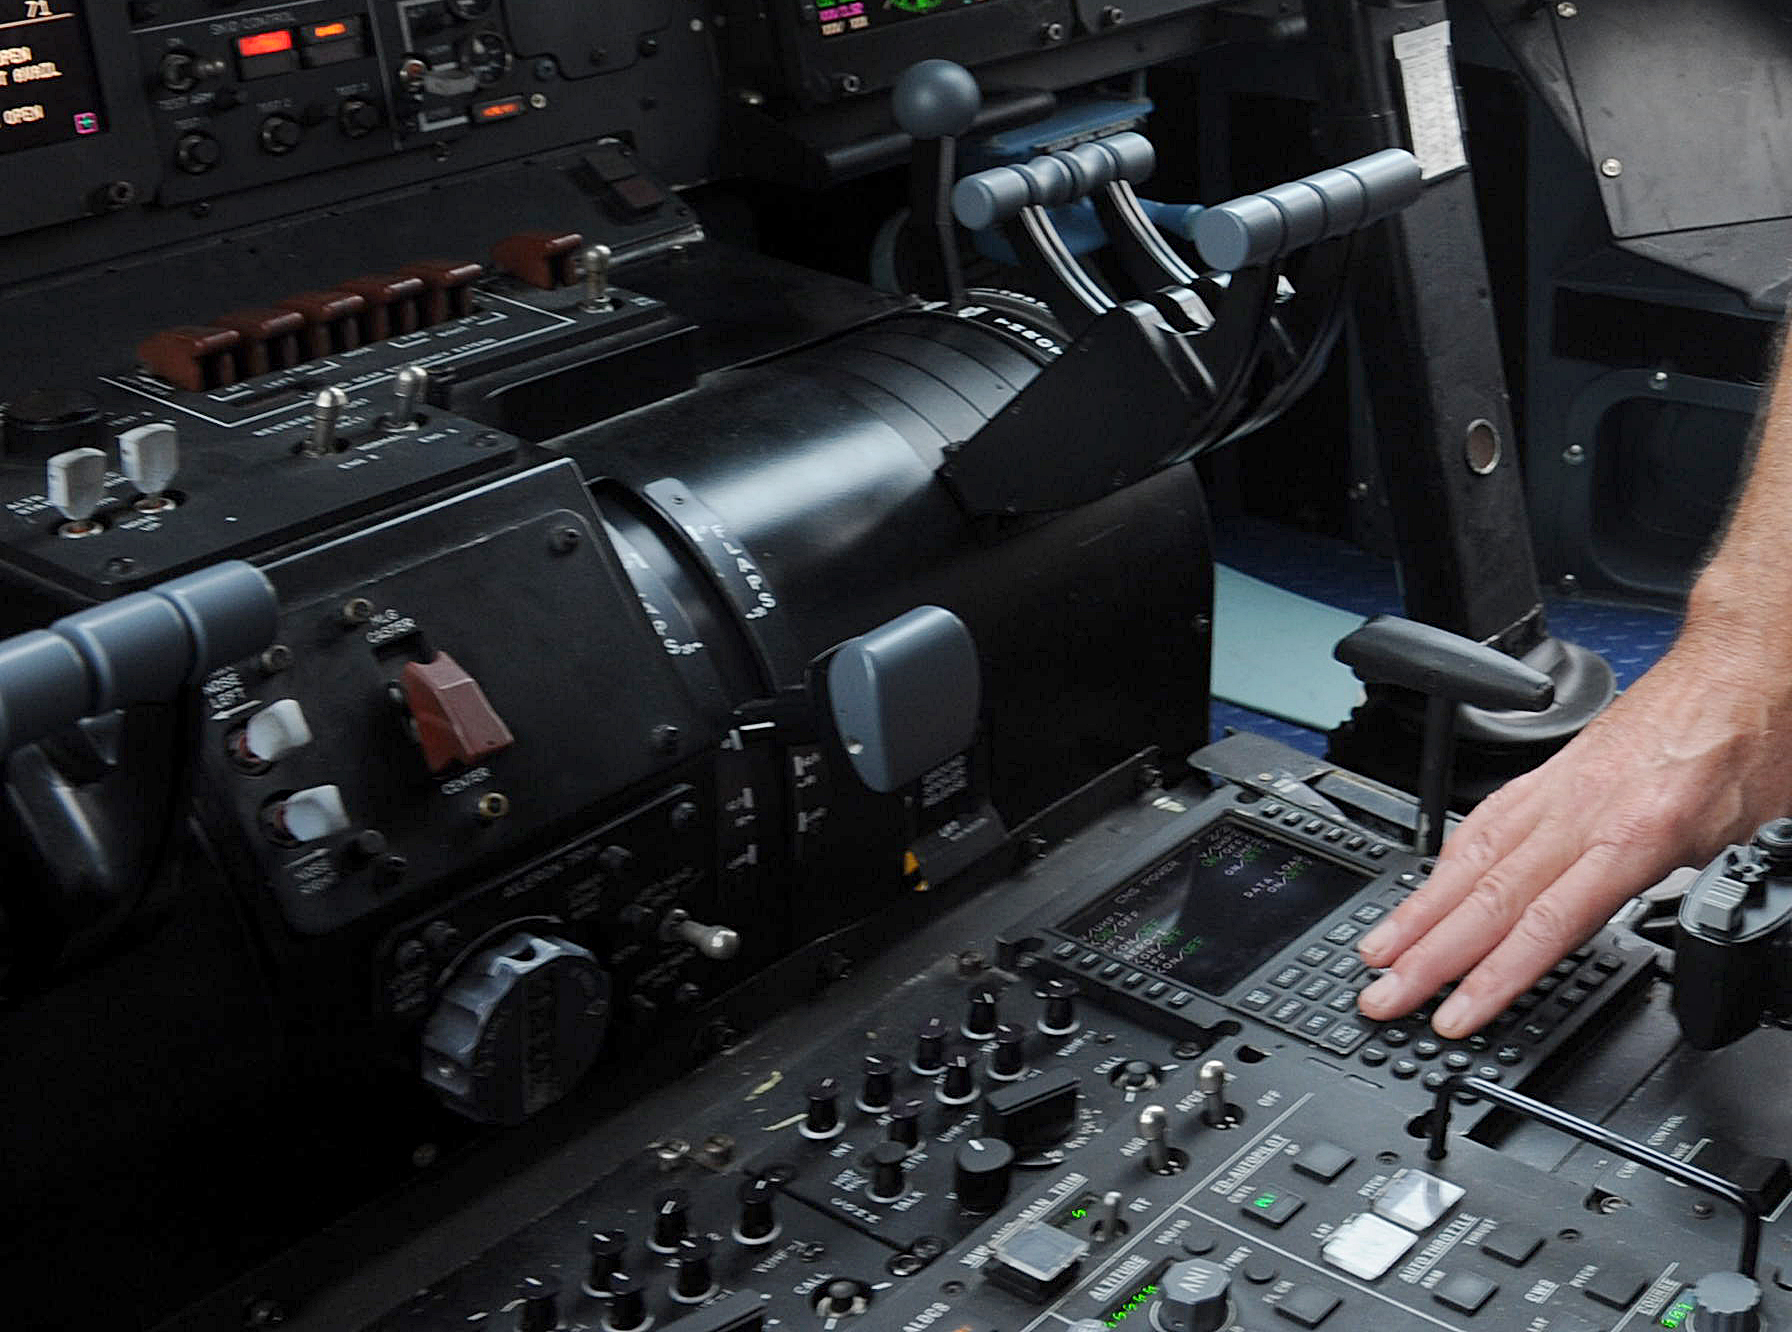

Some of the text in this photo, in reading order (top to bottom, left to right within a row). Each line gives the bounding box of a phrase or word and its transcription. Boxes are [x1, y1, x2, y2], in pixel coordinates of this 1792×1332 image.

[23, 0, 54, 18] 71
[1241, 876, 1274, 900] DATA
[1256, 1089, 1282, 1108] OFF
[1048, 1171, 1089, 1195] TRIM
[1088, 1253, 1150, 1299] ALTITUDE
